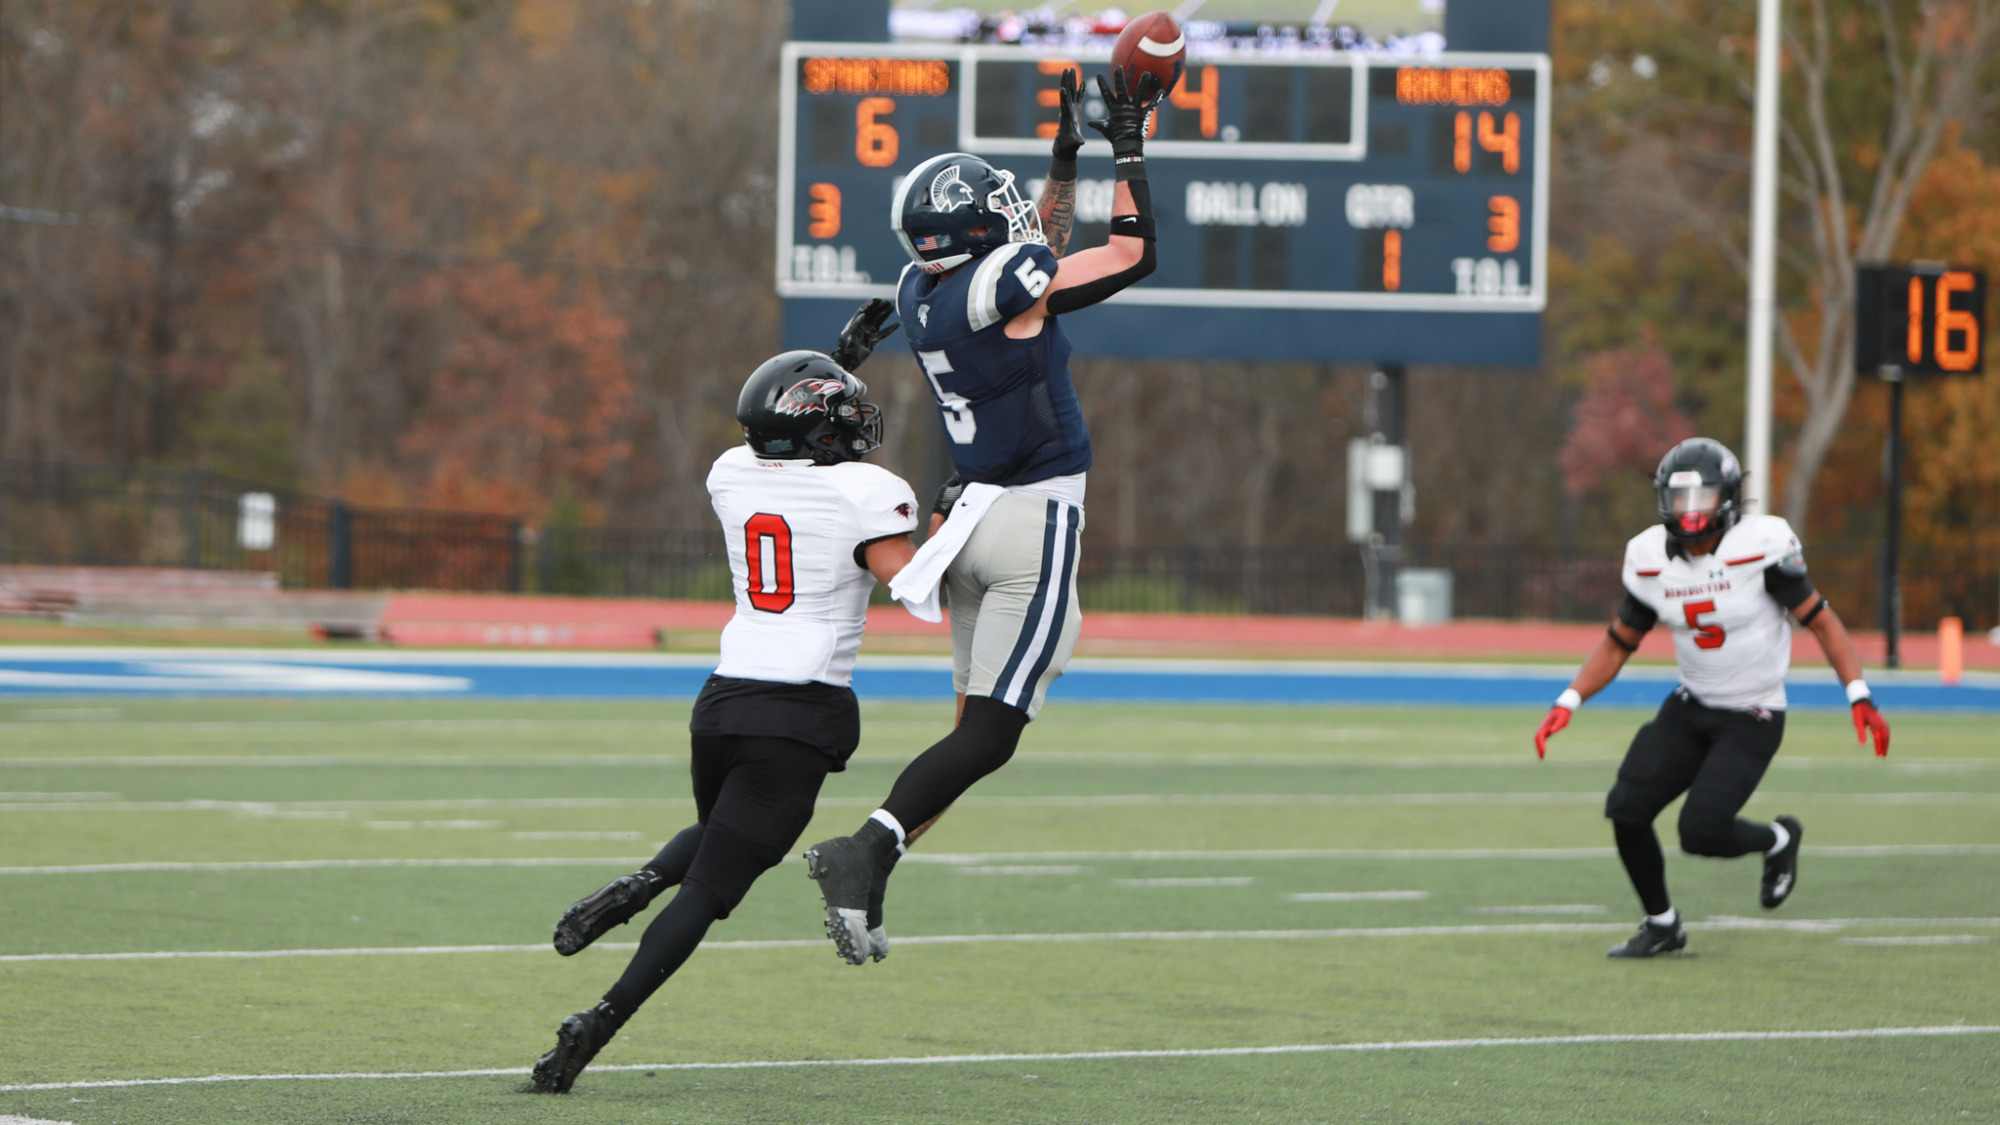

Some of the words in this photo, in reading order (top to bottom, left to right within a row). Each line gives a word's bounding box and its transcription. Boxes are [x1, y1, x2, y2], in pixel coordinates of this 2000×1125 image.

[856, 98, 898, 167] 6
[1454, 111, 1520, 174] 14
[809, 183, 842, 239] 3
[1345, 183, 1415, 229] QTR
[1487, 196, 1520, 253] 3
[1014, 256, 1051, 298] 5
[1383, 230, 1401, 291] 1
[1906, 271, 1979, 371] 16
[917, 350, 977, 444] 5
[744, 512, 795, 613] 0
[1683, 600, 1726, 650] 5
